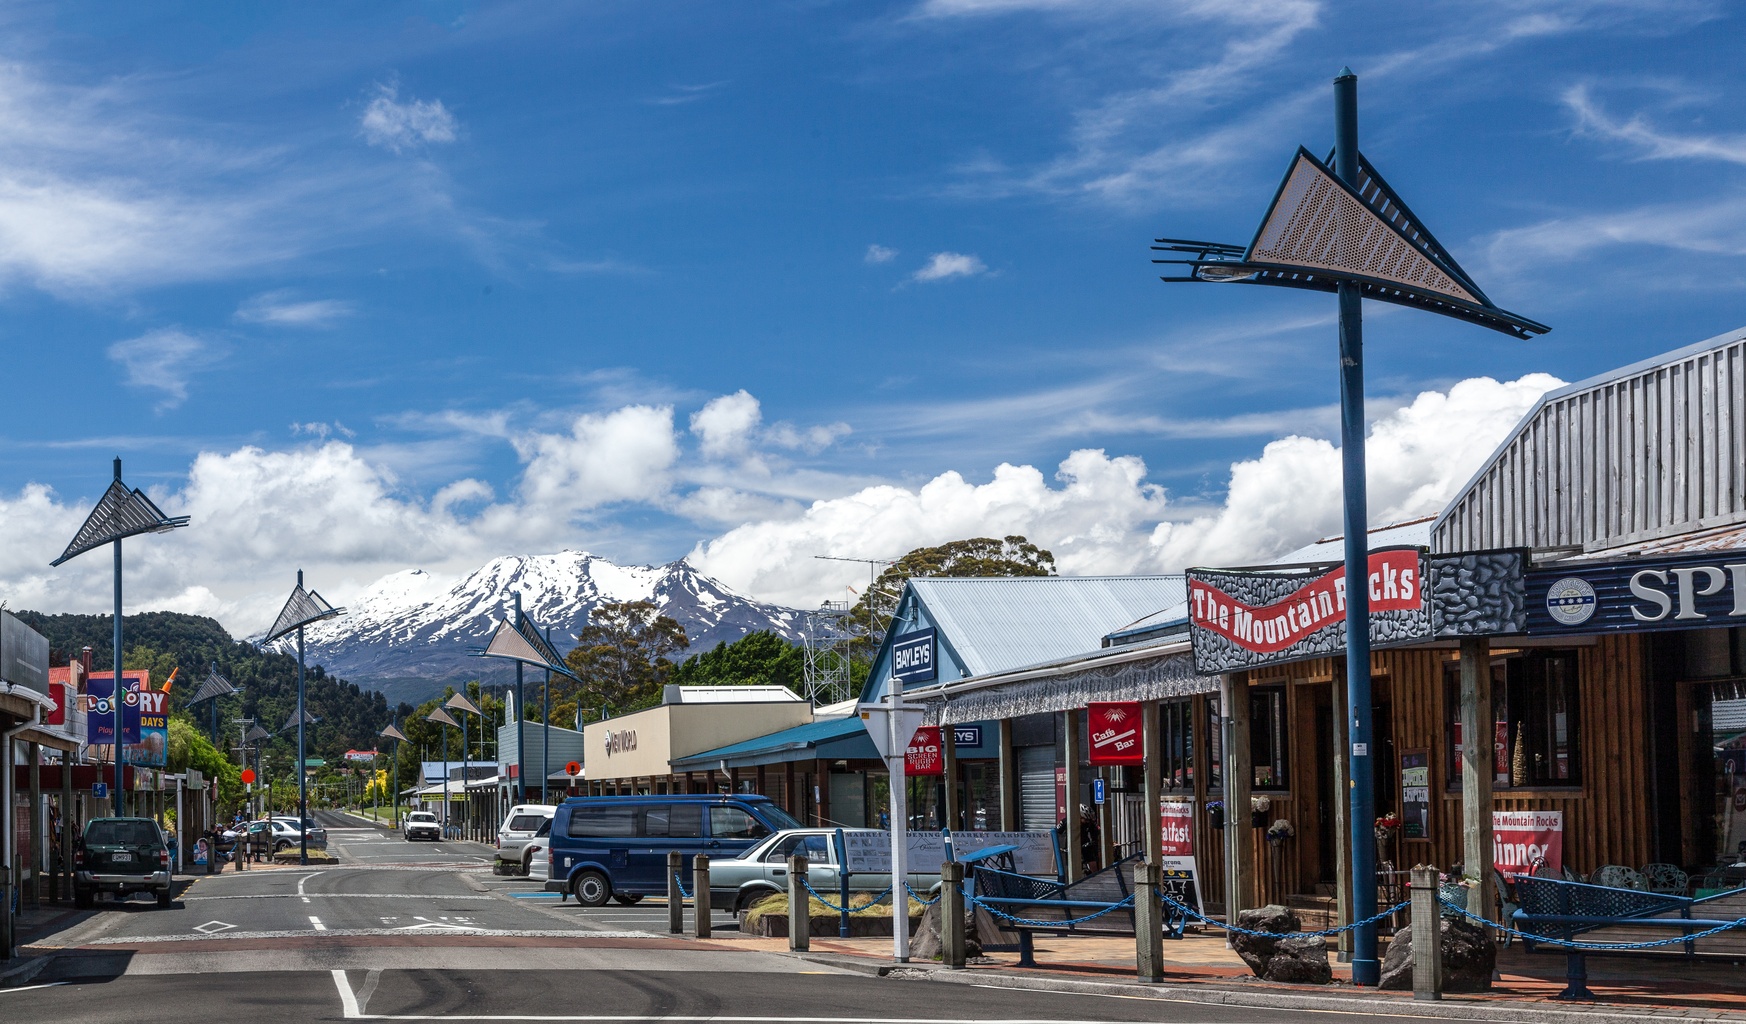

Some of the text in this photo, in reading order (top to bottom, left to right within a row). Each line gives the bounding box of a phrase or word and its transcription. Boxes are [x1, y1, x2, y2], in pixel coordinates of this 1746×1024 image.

[1193, 562, 1414, 645] The Mountain Rcks
[895, 643, 930, 670] BAYLEYS
[140, 716, 164, 727] DAYS
[98, 726, 113, 735] Play
[906, 745, 938, 754] BIG
[1114, 739, 1134, 751] Bar
[907, 752, 938, 760] SCREEN
[1493, 815, 1559, 827] he Mountain Rocks
